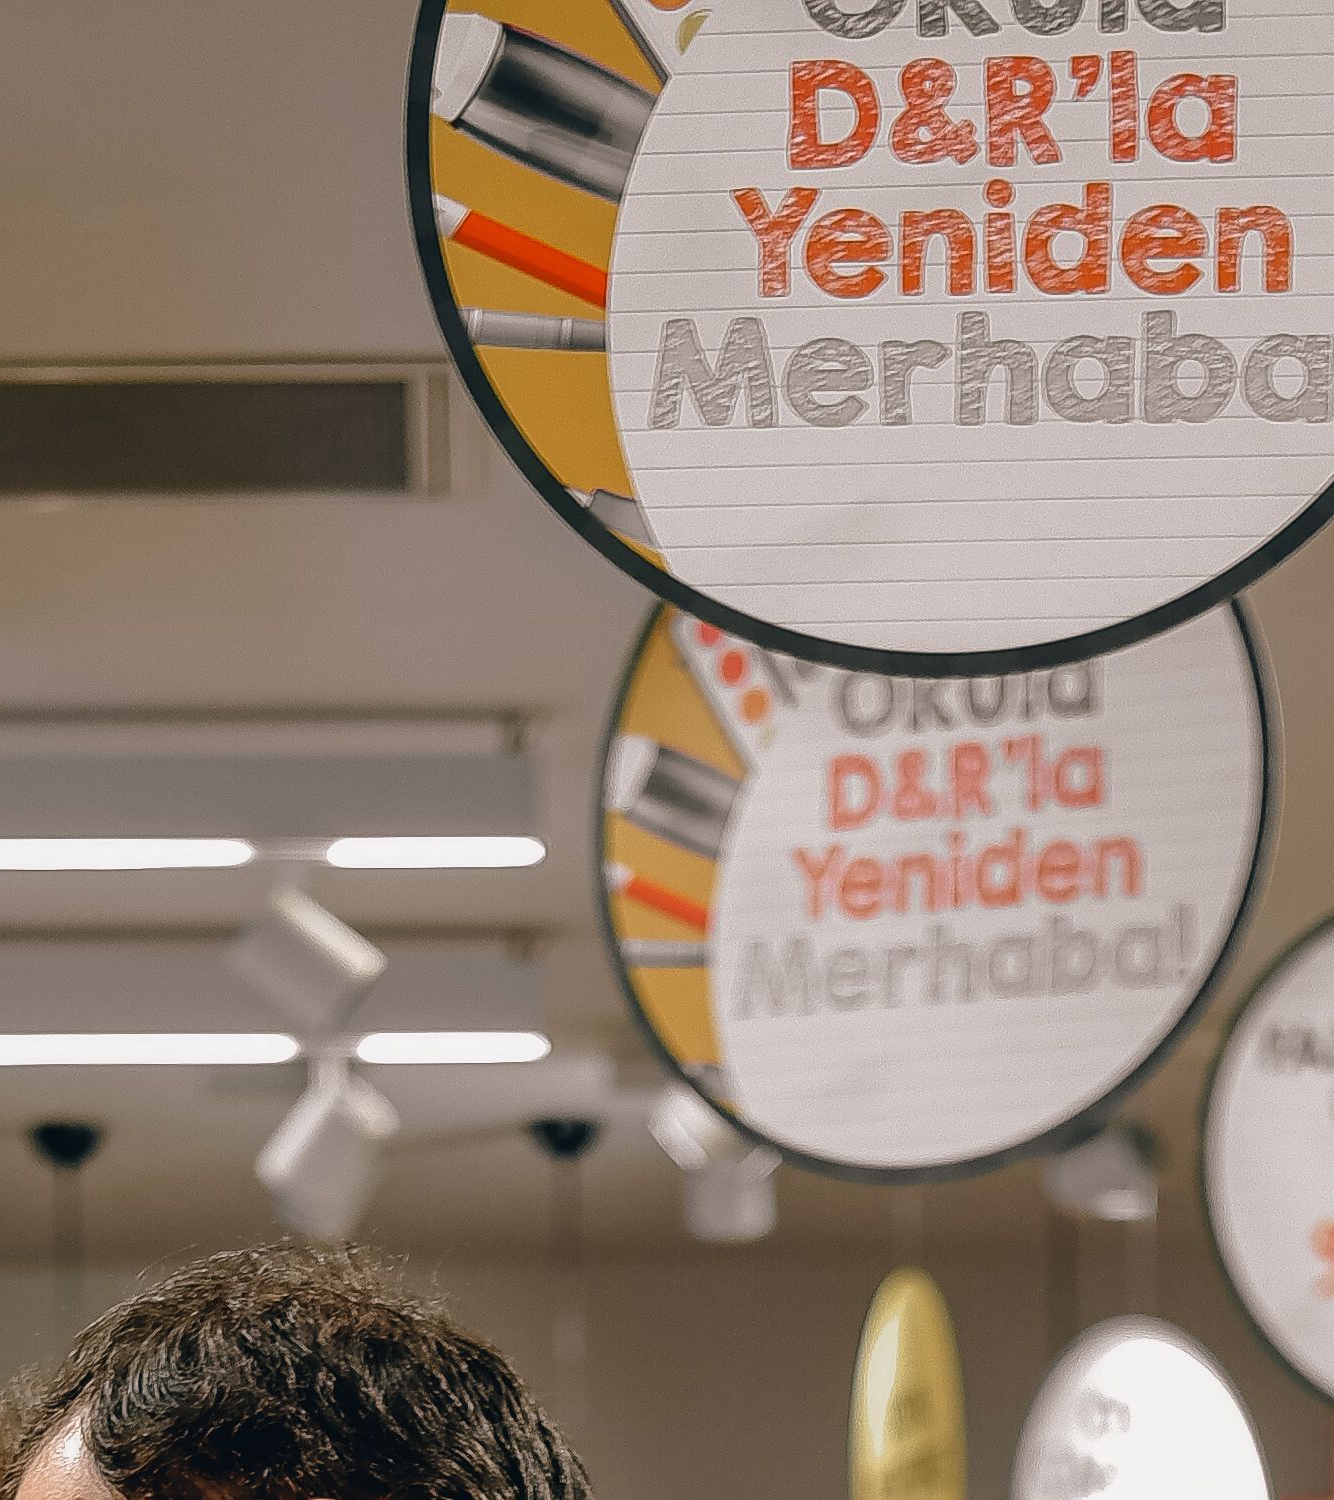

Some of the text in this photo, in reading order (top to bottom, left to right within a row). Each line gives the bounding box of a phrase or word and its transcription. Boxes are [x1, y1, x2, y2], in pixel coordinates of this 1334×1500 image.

[784, 50, 1239, 169] D&R'la
[730, 178, 1295, 298] Yeniden
[792, 832, 1147, 921] Yeniden
[733, 905, 1200, 1020] Merhaba!
